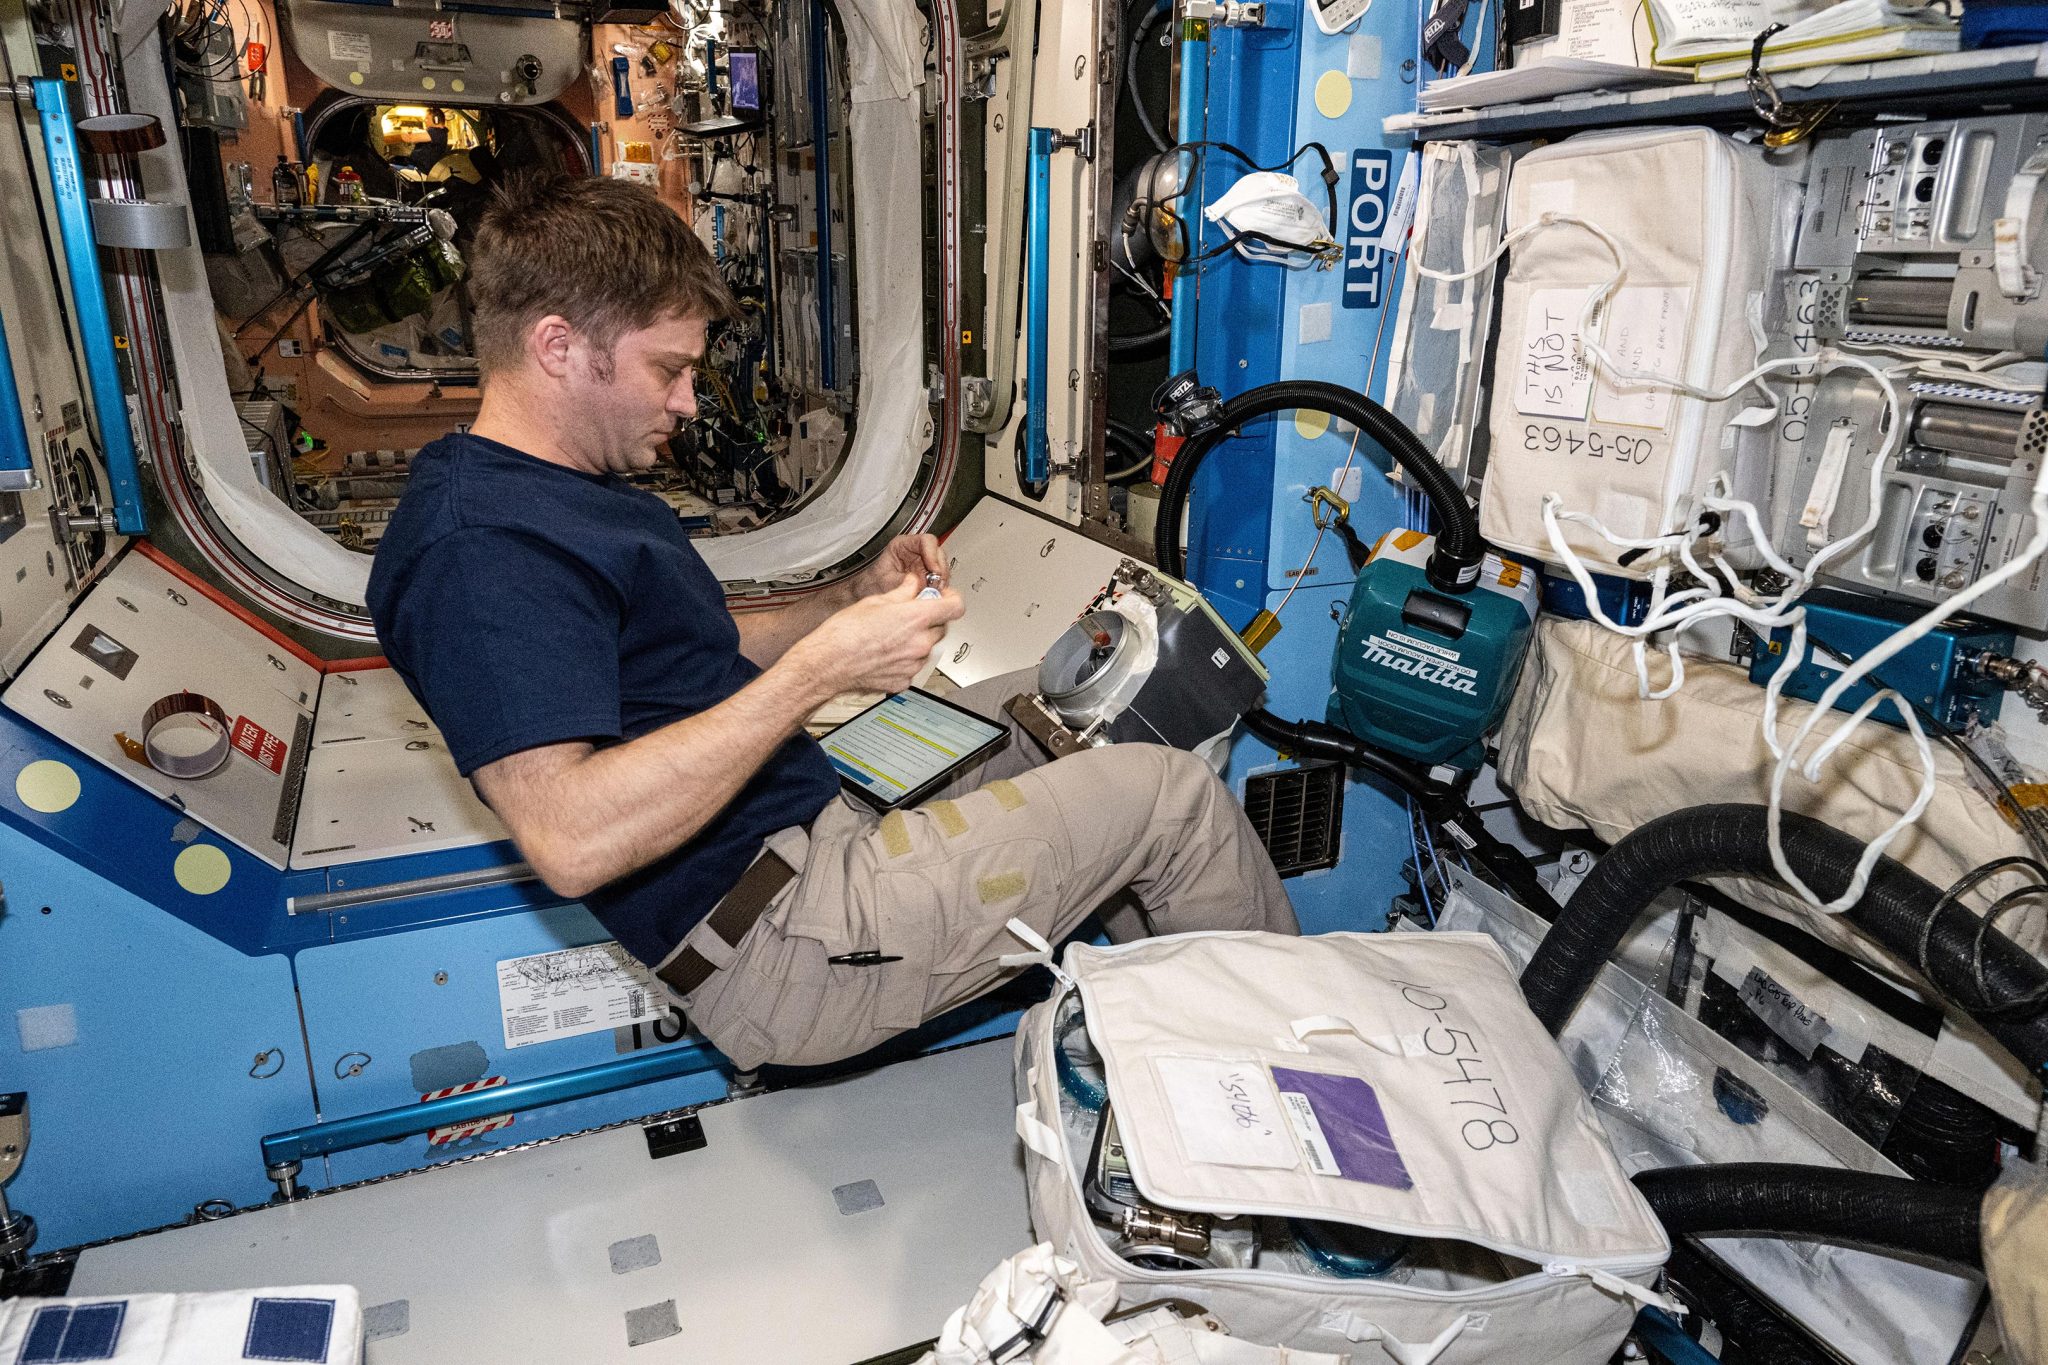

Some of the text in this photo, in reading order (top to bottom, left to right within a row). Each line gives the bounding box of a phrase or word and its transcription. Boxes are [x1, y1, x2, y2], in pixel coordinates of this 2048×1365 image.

[1423, 18, 1446, 44] PETZL
[1346, 158, 1388, 303] PORT
[1525, 337, 1545, 395] THIS
[1545, 307, 1569, 404] IS NOT
[1169, 379, 1194, 401] PETZL
[1525, 424, 1652, 465] 0.5-5463
[1217, 648, 1228, 661] FLOW
[1378, 640, 1471, 675] DO NOT OPEN VACUUM DOOR
[1406, 639, 1435, 651] VACUUM
[238, 723, 260, 752] WATER
[257, 745, 274, 768] MIST
